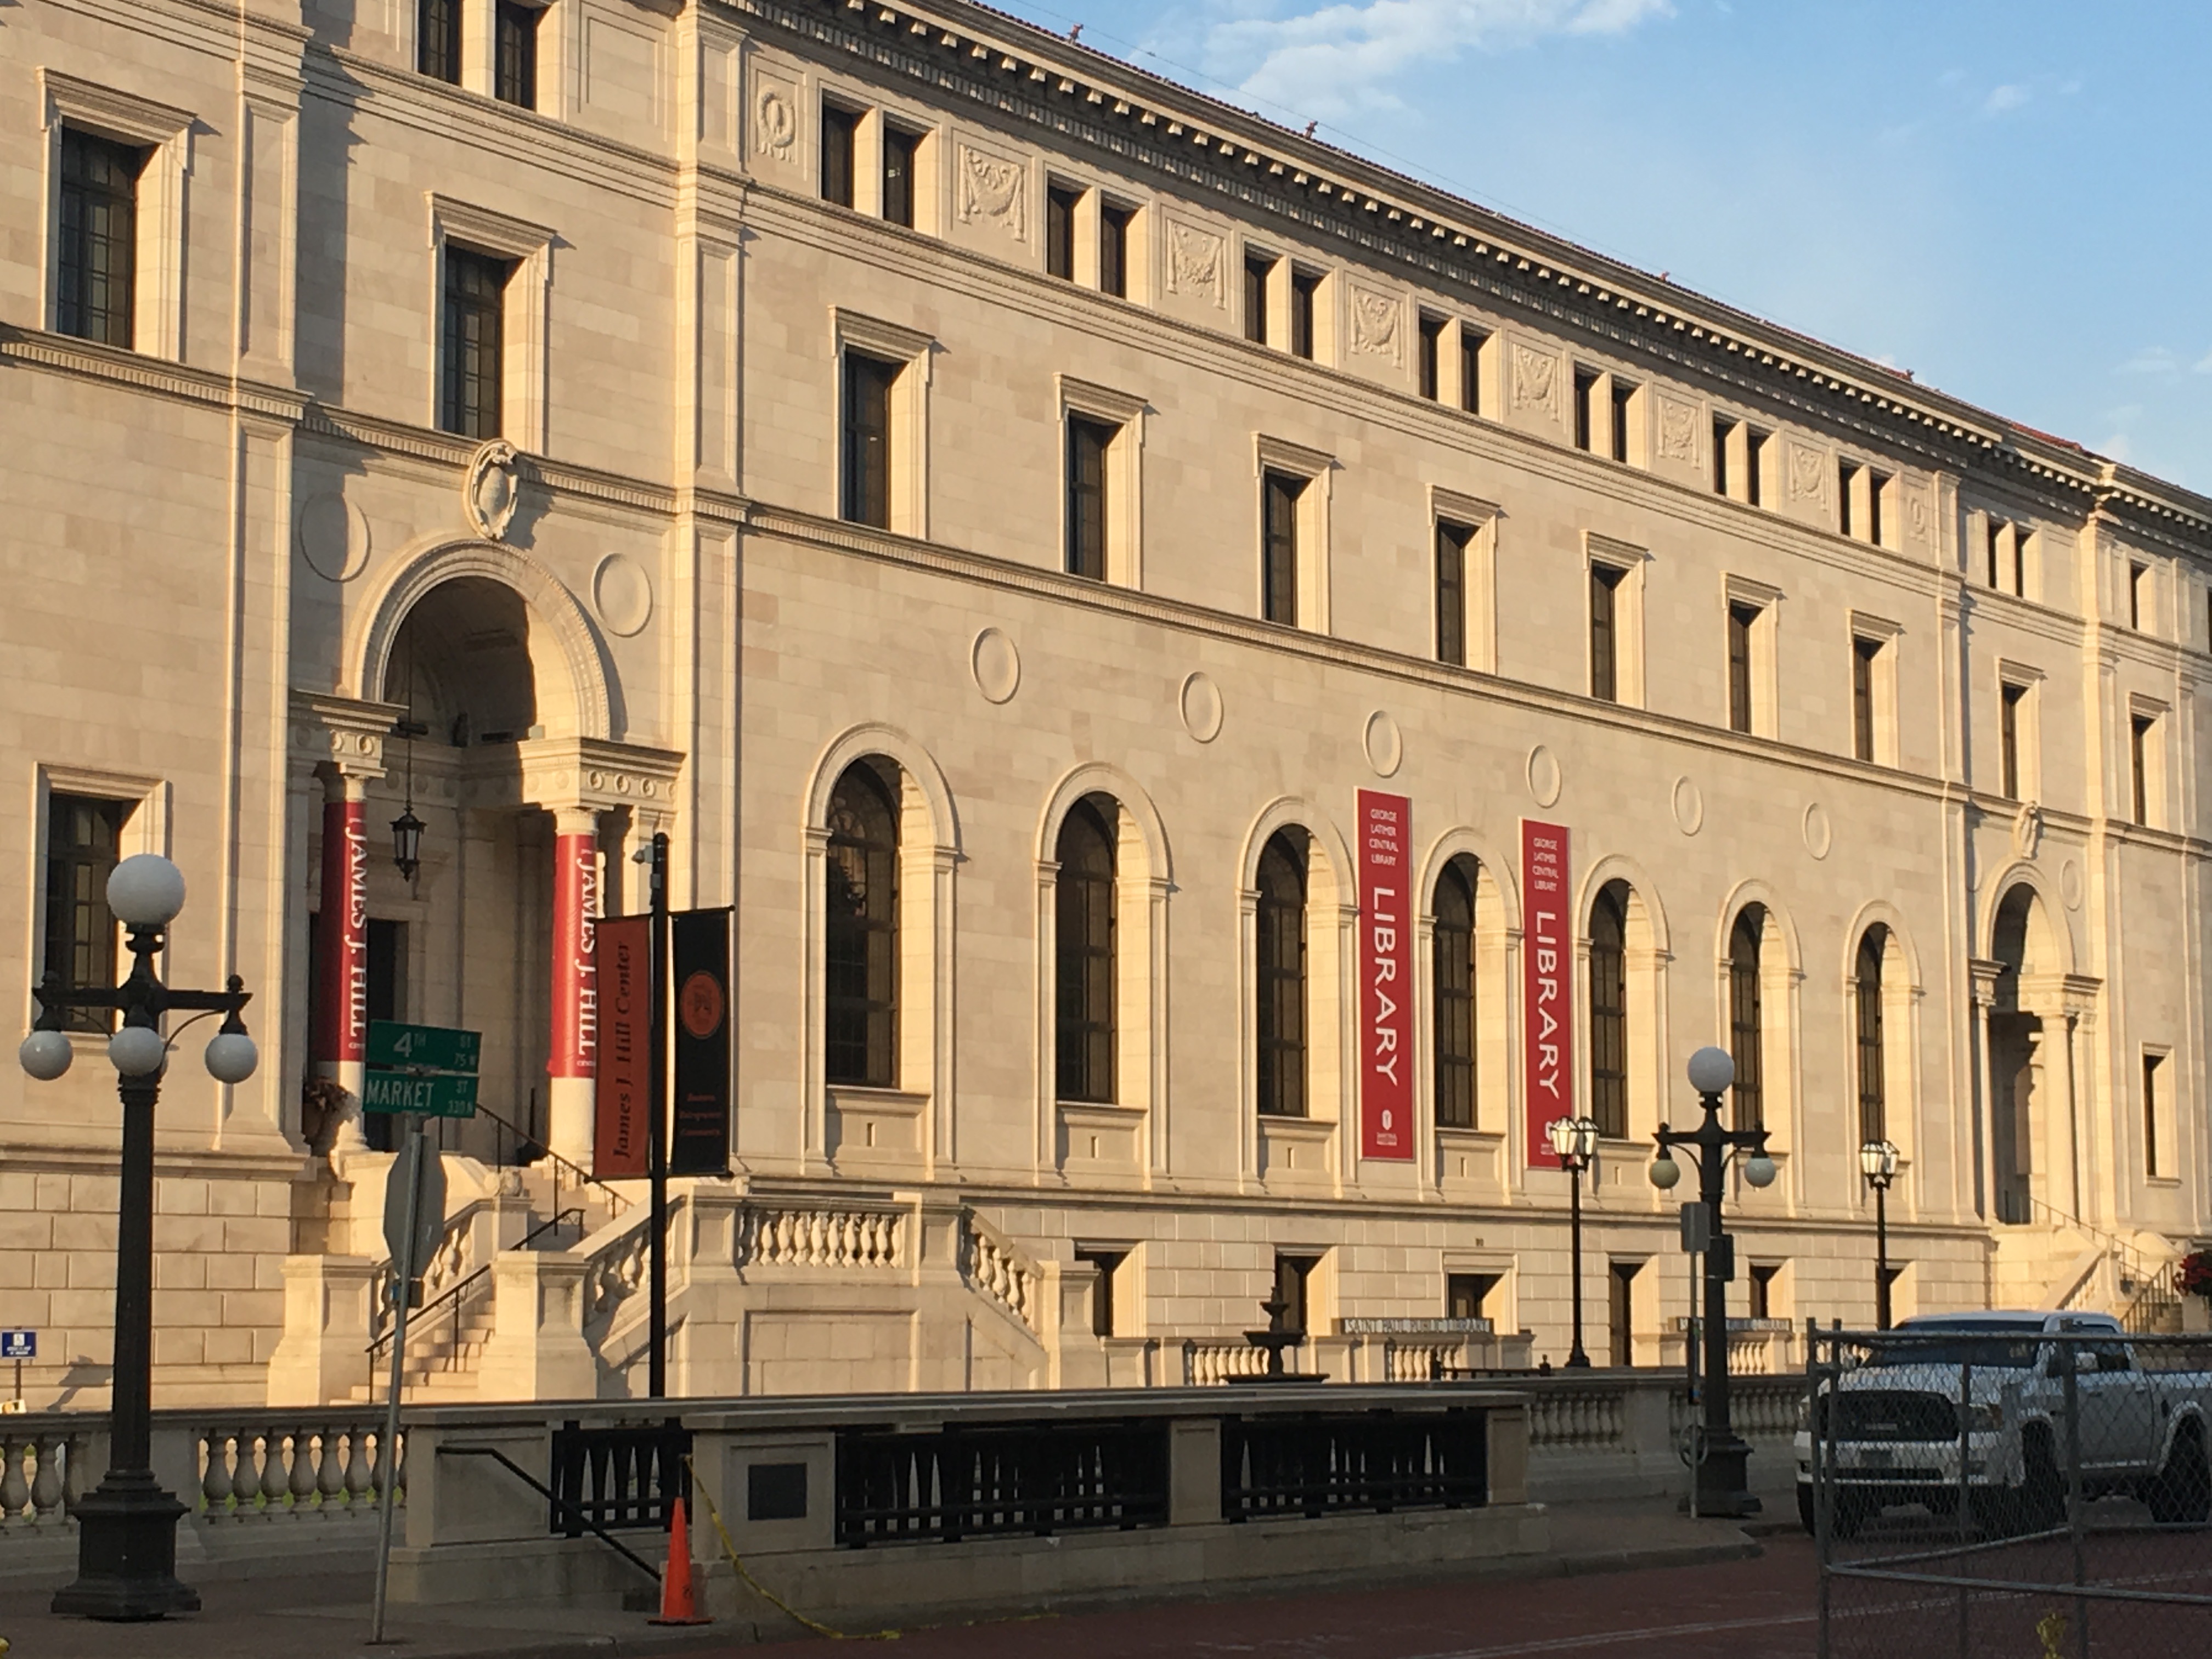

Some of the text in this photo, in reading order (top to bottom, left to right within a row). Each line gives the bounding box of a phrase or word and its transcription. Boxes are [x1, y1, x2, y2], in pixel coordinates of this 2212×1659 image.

[345, 826, 367, 929] JAMES
[577, 857, 595, 955] JAMES
[344, 934, 366, 954] J.
[574, 958, 596, 978] J.
[614, 941, 631, 1015] Center
[349, 964, 367, 1037] HILL
[579, 986, 597, 1056] HILL
[1373, 886, 1397, 1087] LIBRARY
[1536, 911, 1559, 1099] LIBRARY
[614, 1022, 632, 1064] Hill
[365, 1079, 469, 1107] MARKET ST
[613, 1092, 631, 1159] James
